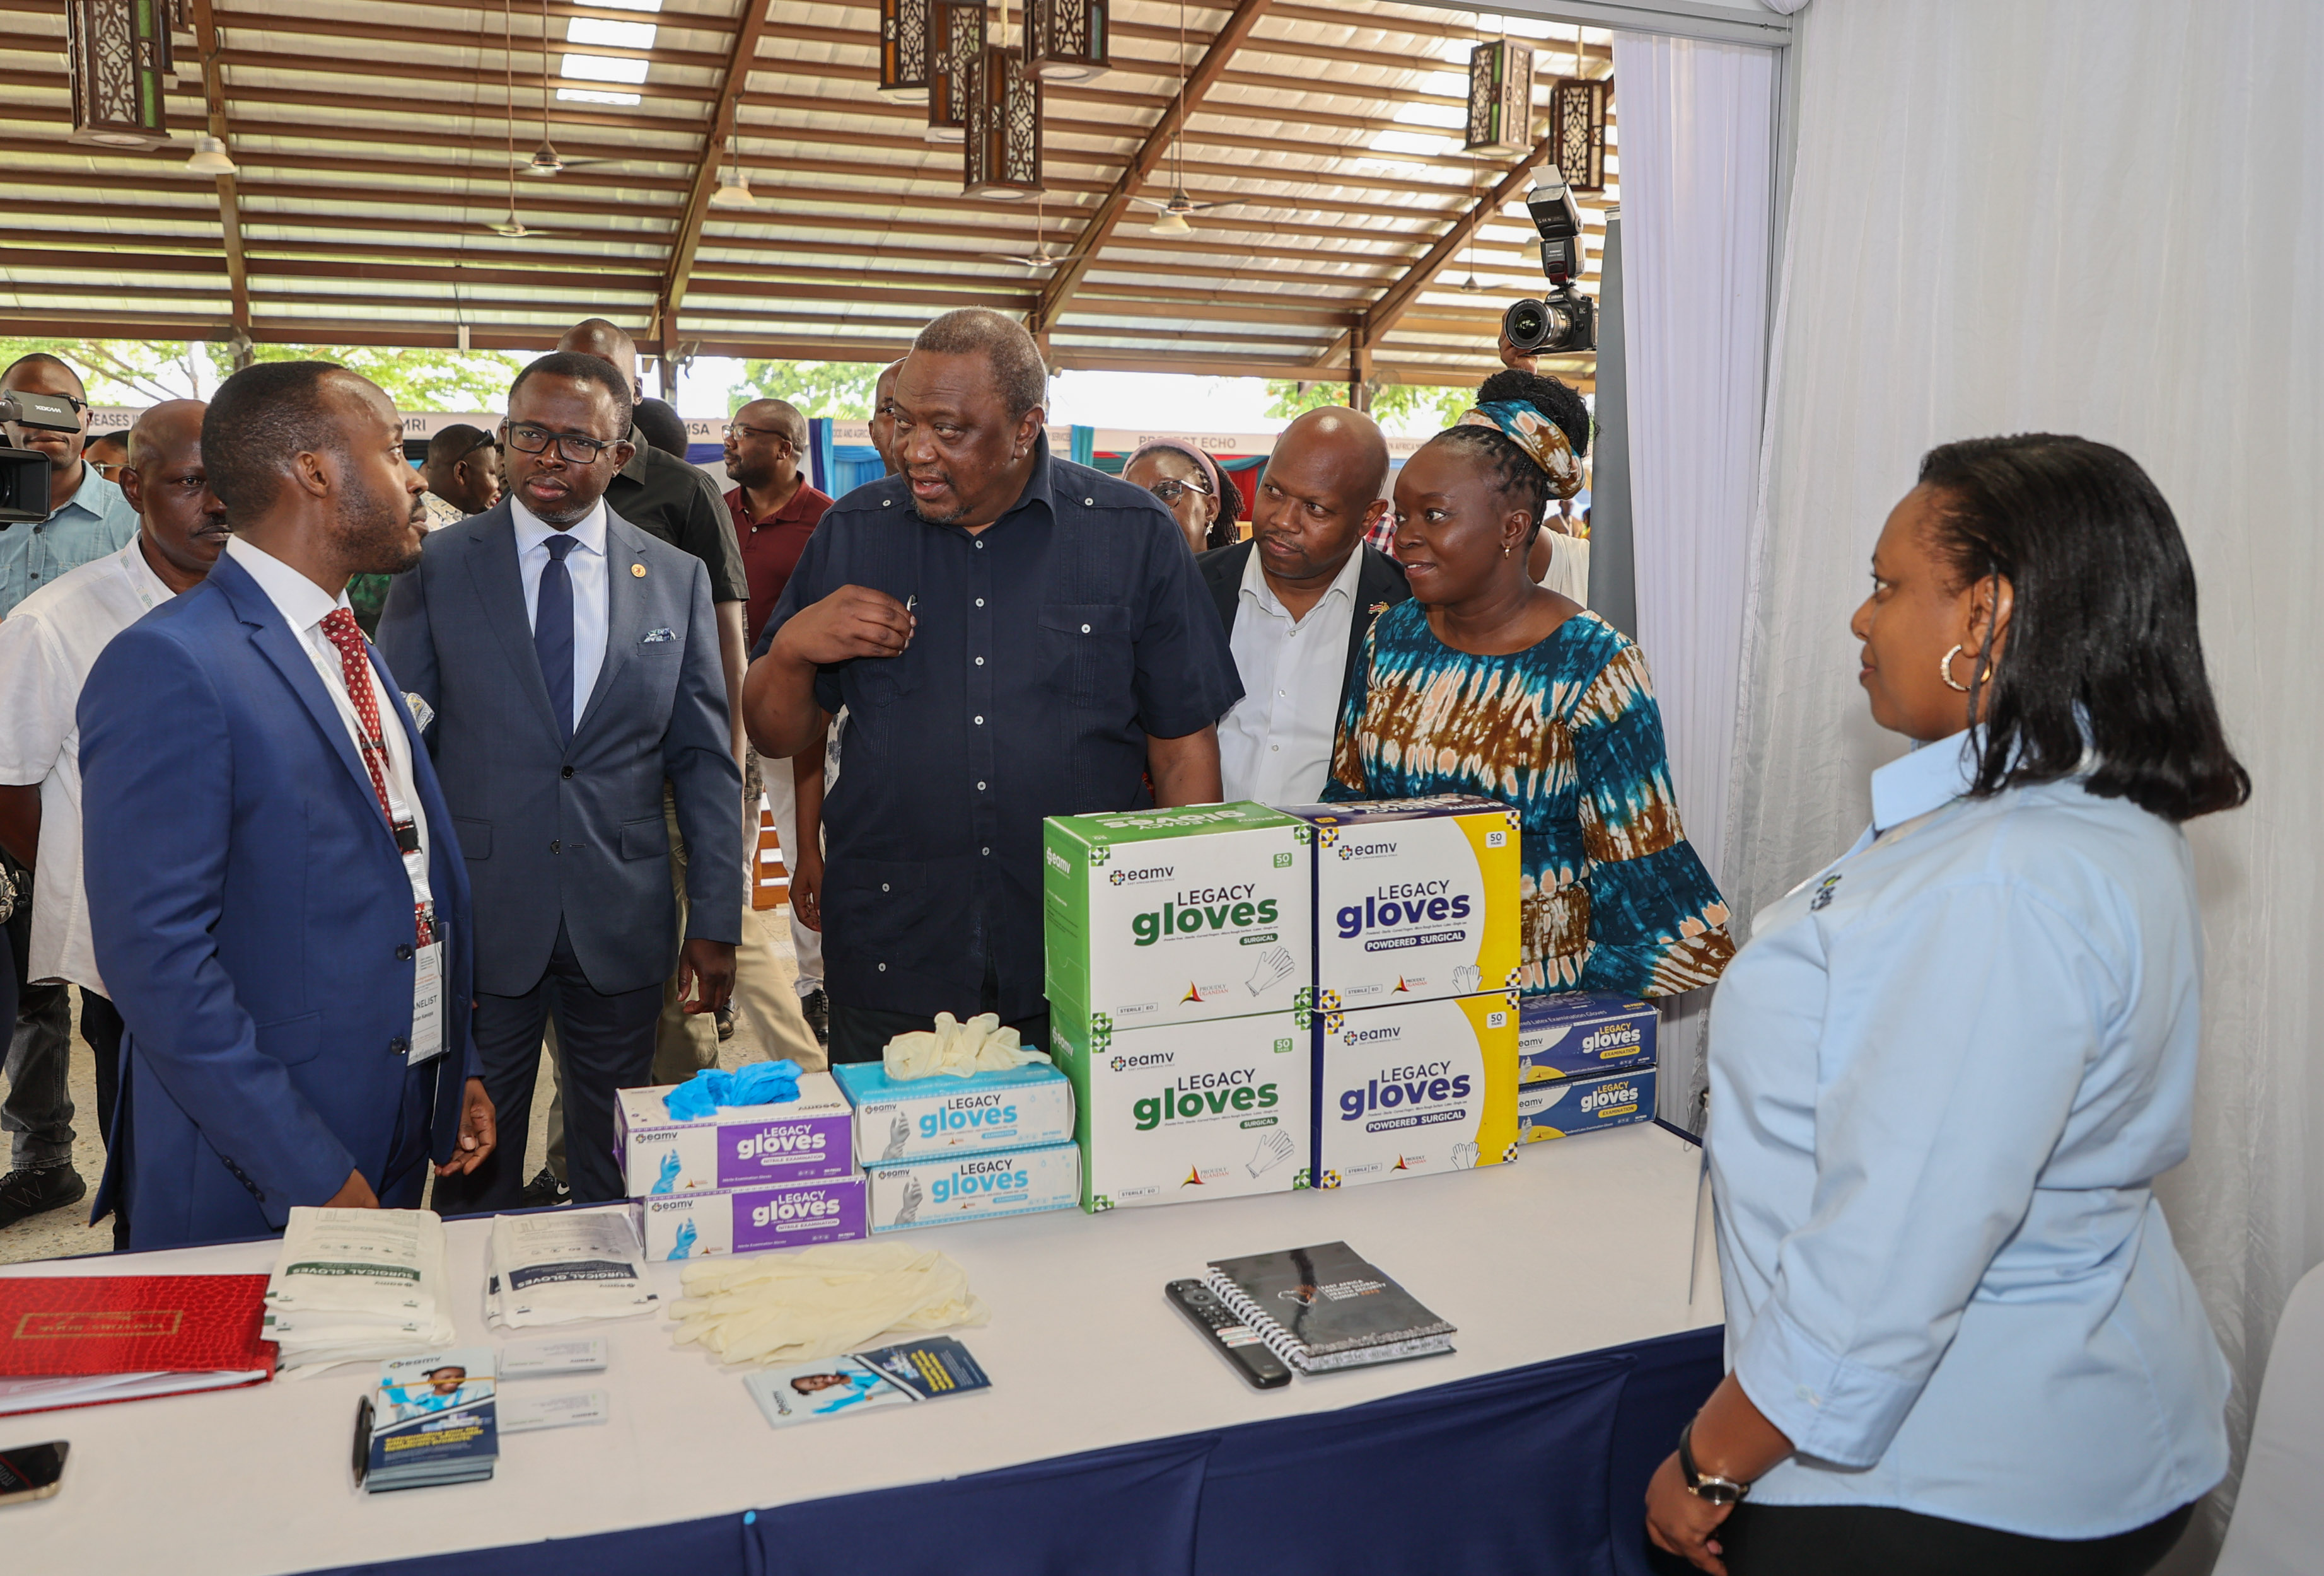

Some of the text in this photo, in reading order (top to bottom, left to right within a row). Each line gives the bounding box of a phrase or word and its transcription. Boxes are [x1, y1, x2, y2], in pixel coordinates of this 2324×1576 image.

[90, 414, 129, 427] SEASES
[404, 419, 426, 431] MRI
[686, 423, 710, 435] MSA
[1202, 437, 1236, 449] ECHO
[1103, 810, 1246, 828] gloves
[1139, 818, 1214, 830] LEGACY
[1490, 833, 1502, 842] 50
[1355, 843, 1397, 855] eamv
[1052, 852, 1071, 874] eamv
[1276, 854, 1289, 864] 50
[1127, 866, 1174, 881] eamv
[1178, 883, 1256, 907] LEGACY
[1378, 879, 1450, 900] LEGACY
[1132, 898, 1279, 946] gloves
[1336, 895, 1470, 939] gloves
[1243, 934, 1275, 944] SURGICAL
[1367, 932, 1463, 951] POWDERED SURGICAL
[1199, 988, 1229, 997] UGANDAN
[415, 995, 438, 1009] NELIST
[1491, 1014, 1502, 1022] 50
[1548, 1013, 1585, 1022] Examination
[1359, 1027, 1400, 1041] eamv
[1600, 1022, 1632, 1034] LEGACY
[1057, 1035, 1073, 1057] eamv
[1277, 1039, 1289, 1049] 50
[1519, 1038, 1543, 1047] eamv
[1582, 1028, 1641, 1053] gloves
[1604, 1048, 1637, 1057] EXAMINATION
[1129, 1052, 1174, 1067] eamv
[1381, 1060, 1451, 1083] LEGACY
[1178, 1069, 1256, 1091] LEGACY
[1598, 1081, 1629, 1094] LEGACY
[948, 1094, 1001, 1110] LEGACY
[1340, 1075, 1471, 1121] gloves
[1519, 1098, 1543, 1108] eamv
[1581, 1087, 1638, 1113] gloves
[1133, 1083, 1279, 1131] gloves
[1602, 1106, 1634, 1116] EXAMINATION
[919, 1105, 1018, 1139] gloves
[1244, 1118, 1275, 1127] SURGICAL
[1368, 1111, 1463, 1132] POWDERED SURGICAL
[647, 1132, 678, 1140] eamv
[764, 1124, 812, 1138] LEGACY
[737, 1133, 827, 1160] gloves
[886, 1169, 910, 1178] eamv
[961, 1159, 1013, 1176] LEGACY
[931, 1169, 1029, 1203] gloves
[778, 1190, 826, 1205] LEGACY
[663, 1200, 693, 1209] eamv
[752, 1198, 840, 1227] gloves
[800, 1220, 837, 1228] EXAMINATION
[293, 1266, 346, 1275] GLOVES
[350, 1268, 414, 1279] SURGICAL
[517, 1271, 631, 1288] SURGICAL GLOVES
[1355, 1283, 1386, 1292] SECURITY
[404, 1356, 441, 1365] eamv
